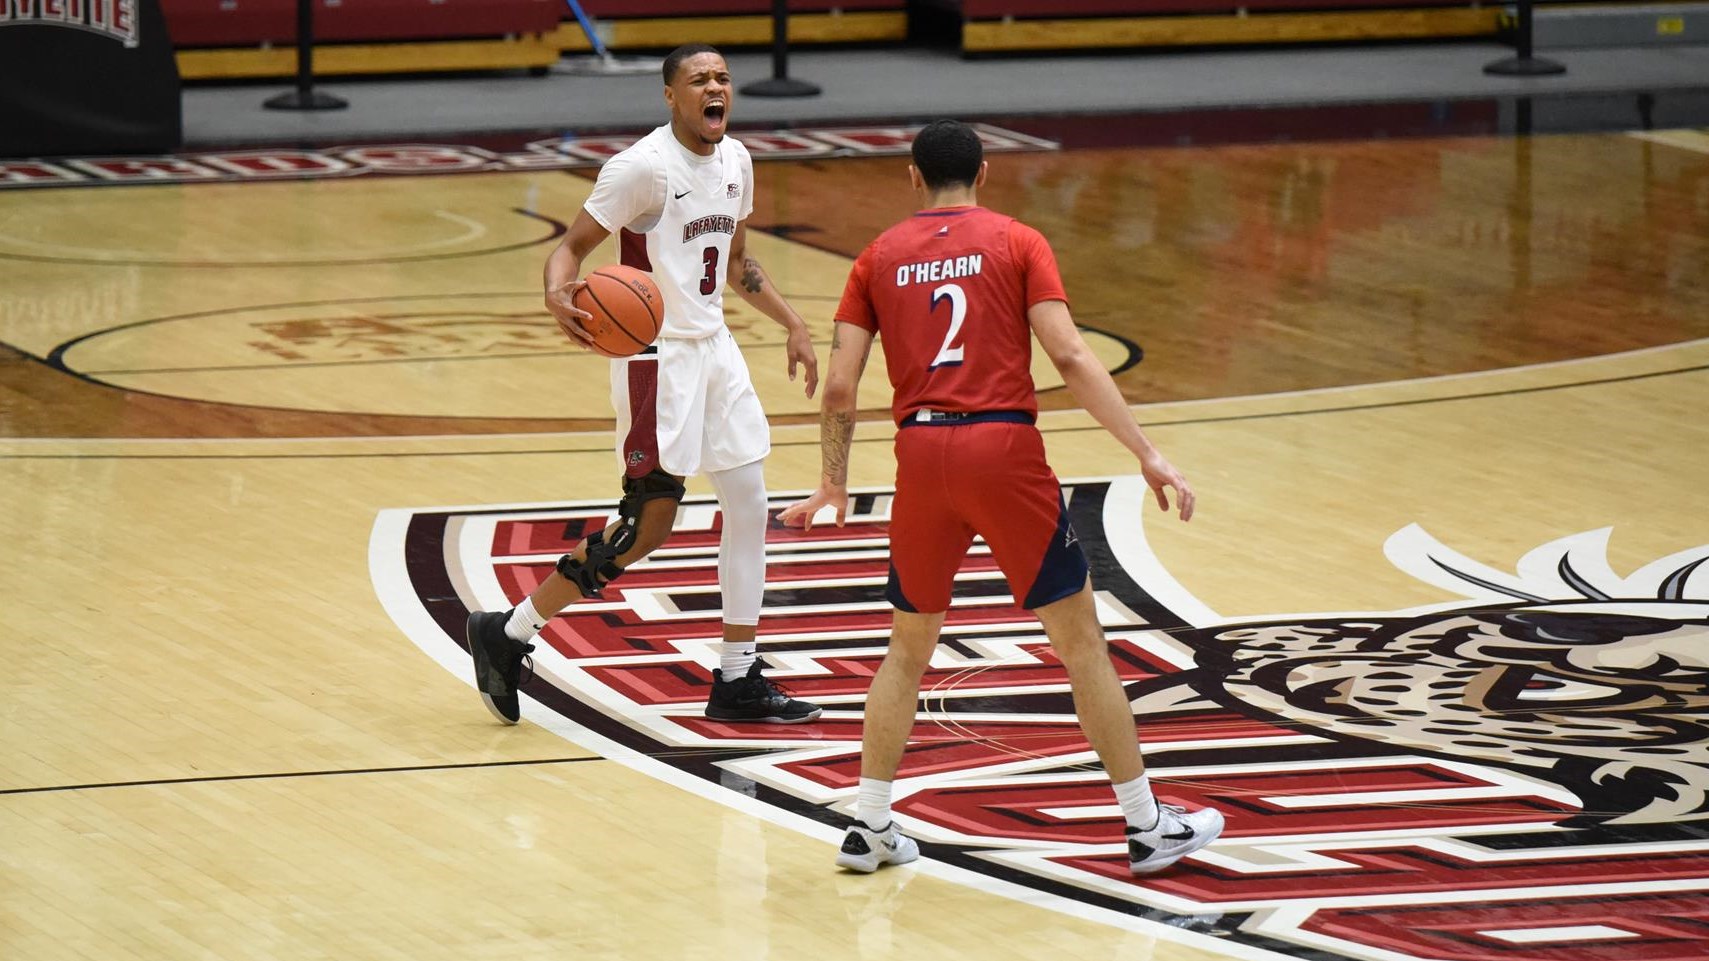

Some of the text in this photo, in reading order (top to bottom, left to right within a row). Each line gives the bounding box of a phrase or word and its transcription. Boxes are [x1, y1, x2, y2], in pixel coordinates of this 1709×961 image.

[683, 214, 736, 243] LAFAYETTE
[699, 246, 719, 296] 3
[896, 254, 982, 287] O'HEARN
[929, 283, 967, 372] 2
